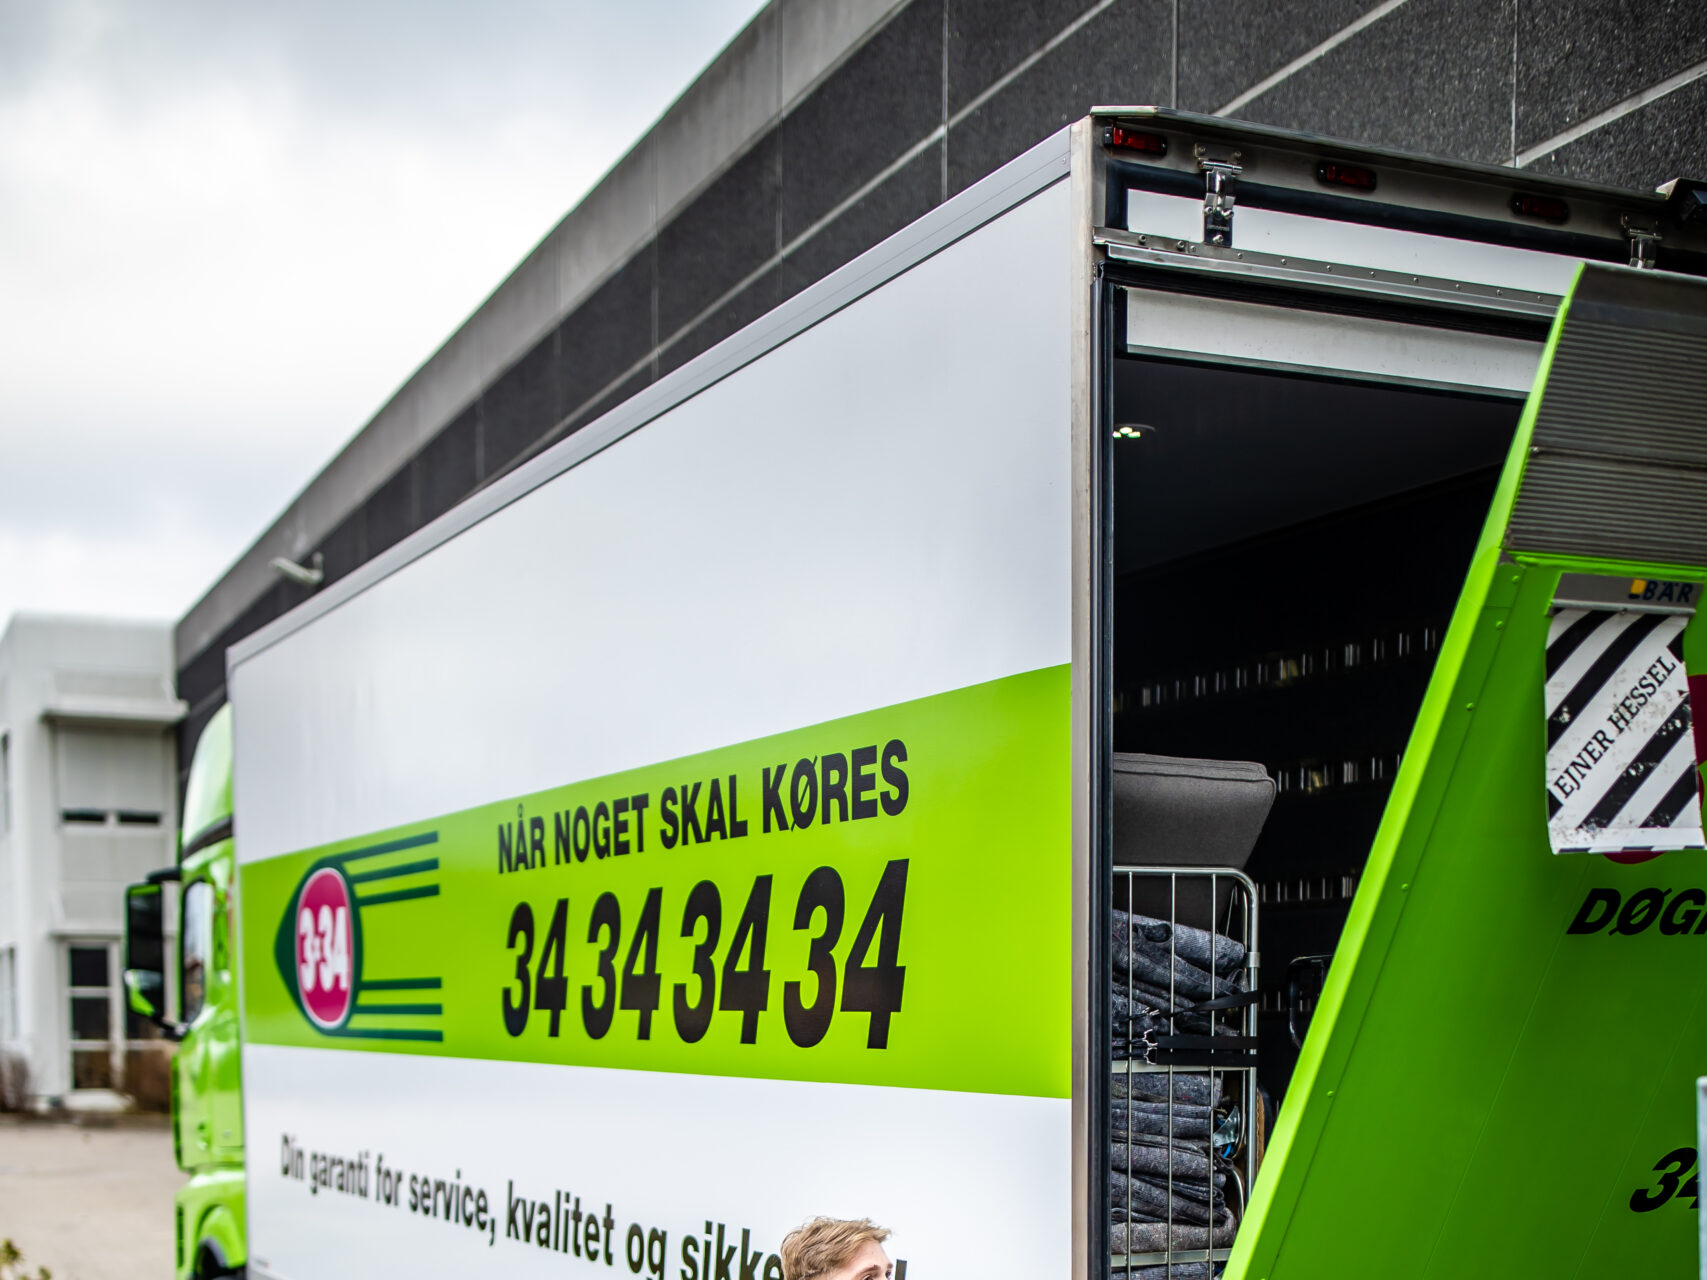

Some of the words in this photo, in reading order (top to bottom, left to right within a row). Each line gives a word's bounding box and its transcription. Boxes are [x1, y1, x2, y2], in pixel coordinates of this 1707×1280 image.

[1643, 580, 1694, 603] BÄR
[1554, 729, 1615, 799] EJNER
[1607, 656, 1677, 735] HESSEL
[498, 803, 546, 874] NÅR
[554, 793, 650, 866] NOGET
[660, 774, 748, 850] SKAL
[762, 739, 909, 833] KØRES
[502, 898, 569, 1038] 34
[581, 887, 663, 1040] 34
[673, 874, 773, 1044] 34
[783, 858, 910, 1049] 34
[1566, 887, 1707, 936] DØG
[281, 1132, 304, 1180] Din
[310, 1150, 369, 1196] garanti
[376, 1153, 402, 1207] for
[409, 1168, 496, 1247] service,
[506, 1179, 615, 1267] kvalitet
